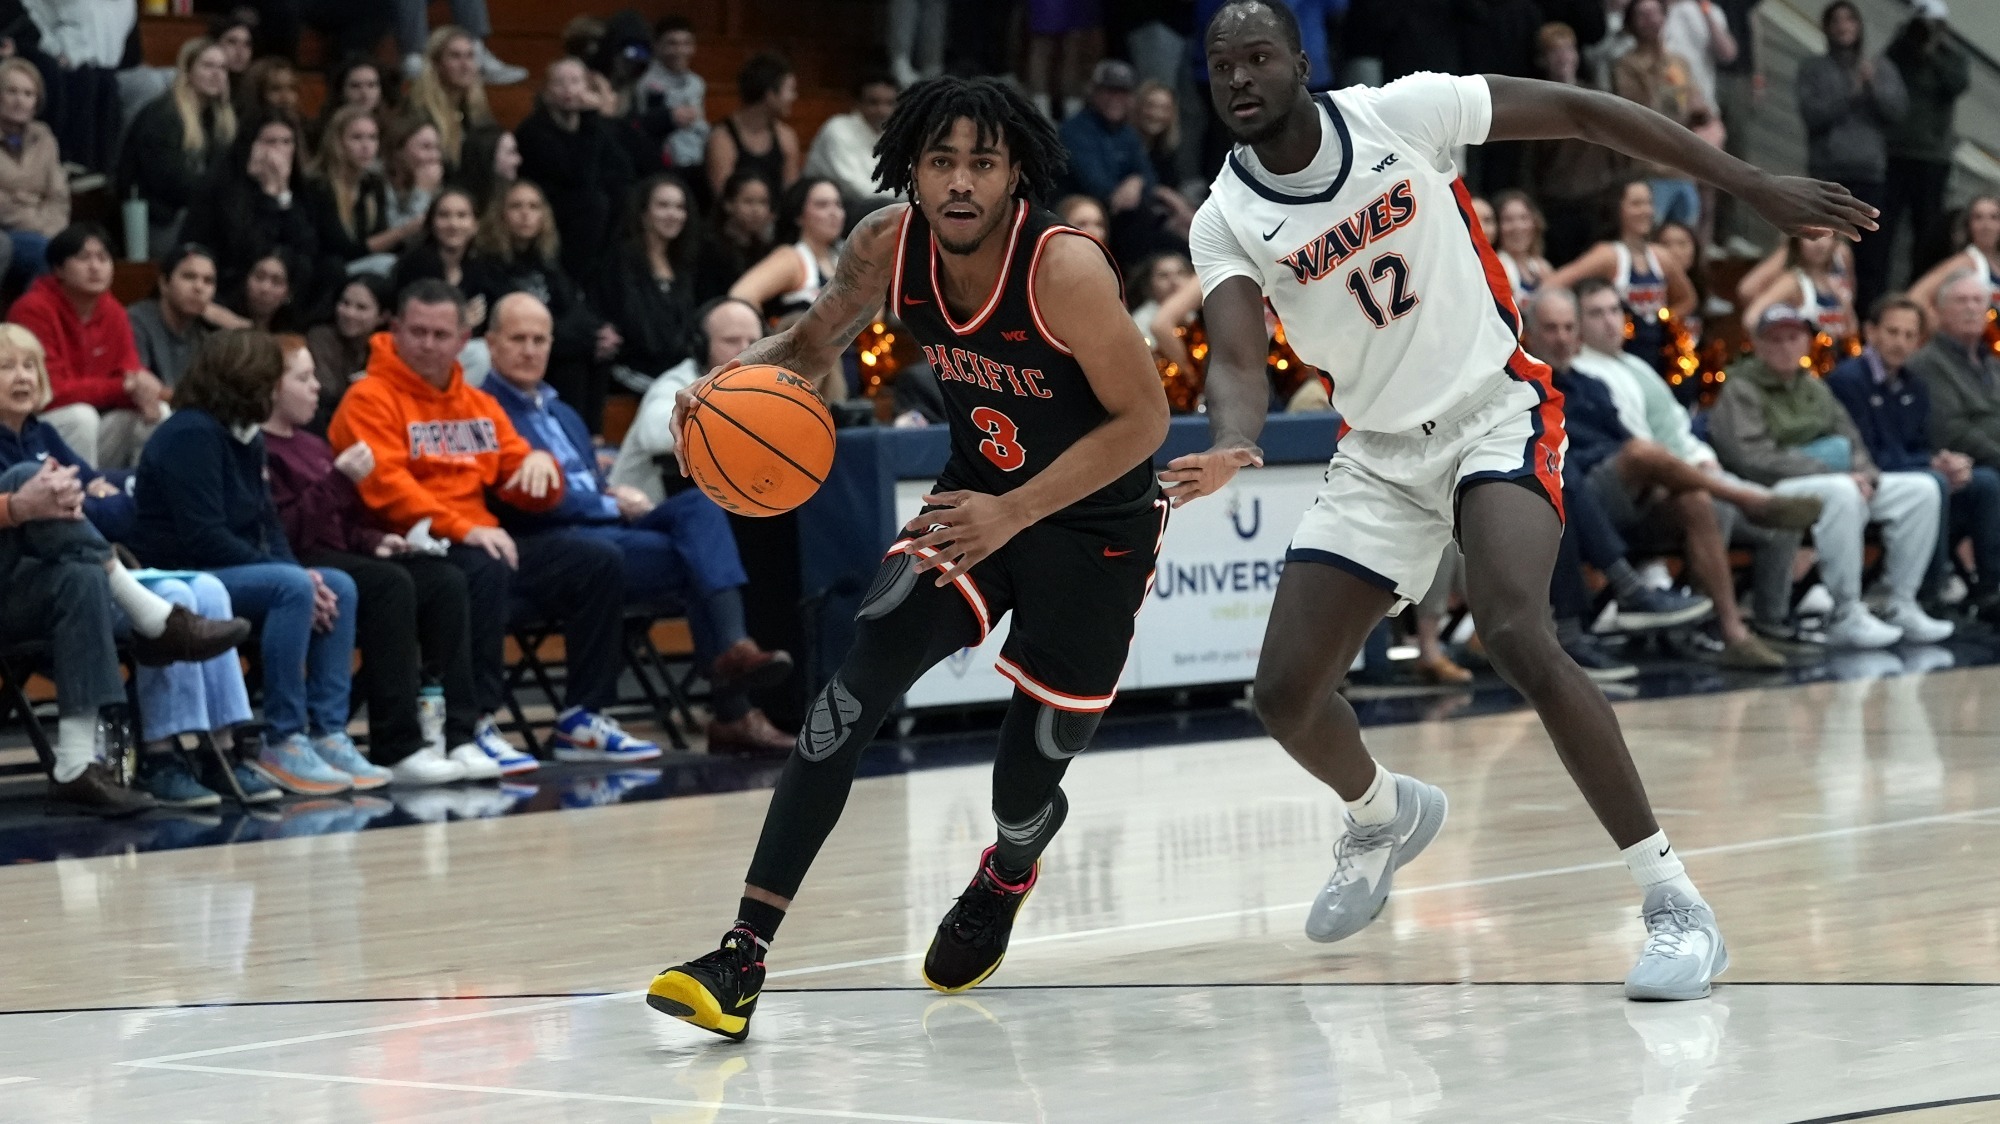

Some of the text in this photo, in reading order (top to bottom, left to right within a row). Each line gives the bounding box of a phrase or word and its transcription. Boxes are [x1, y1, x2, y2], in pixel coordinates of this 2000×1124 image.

[1371, 153, 1399, 173] WCC
[1275, 179, 1417, 285] WAVES
[1346, 251, 1420, 329] 12
[1001, 330, 1029, 342] WCC
[922, 344, 1053, 398] PACIFIC
[970, 406, 1027, 472] 3
[1421, 420, 1436, 436] P
